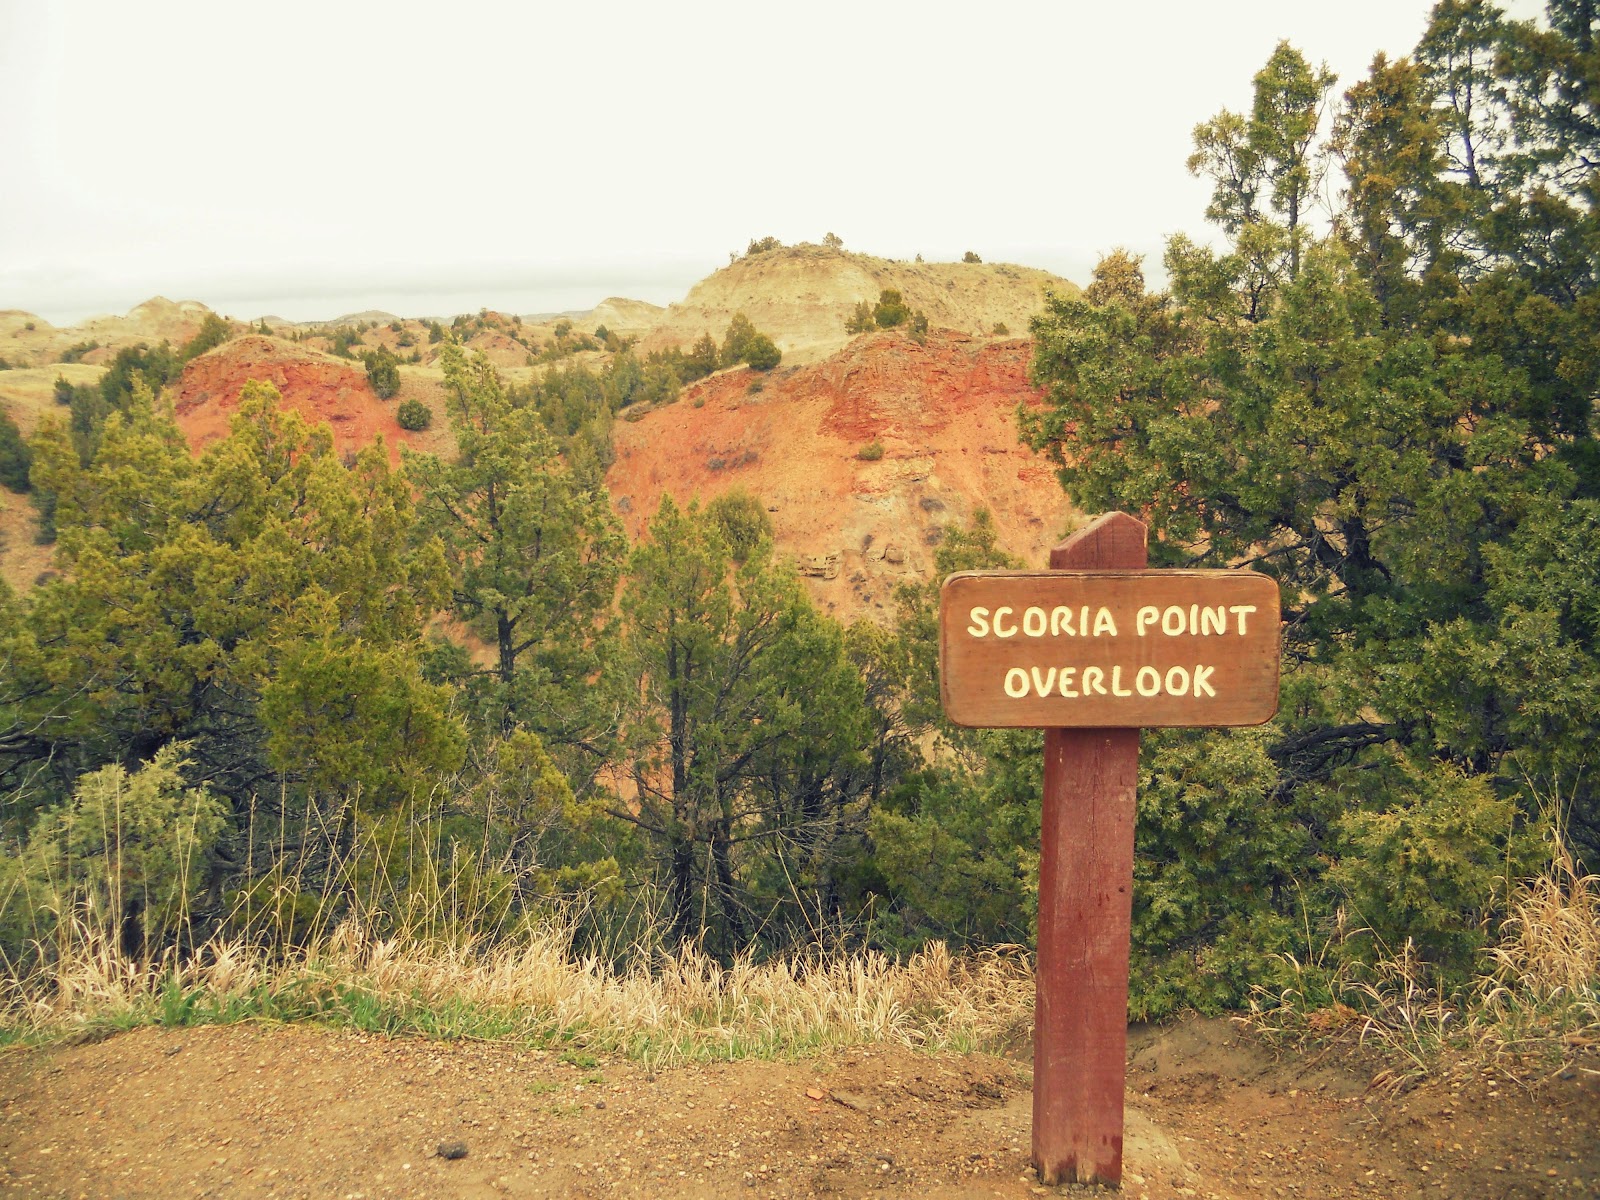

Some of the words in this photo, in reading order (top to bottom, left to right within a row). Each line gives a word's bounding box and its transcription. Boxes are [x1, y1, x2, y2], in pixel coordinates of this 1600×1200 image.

[967, 606, 1118, 638] SCORIA
[1136, 604, 1257, 637] POINT
[1003, 664, 1216, 698] OVERLOOK
